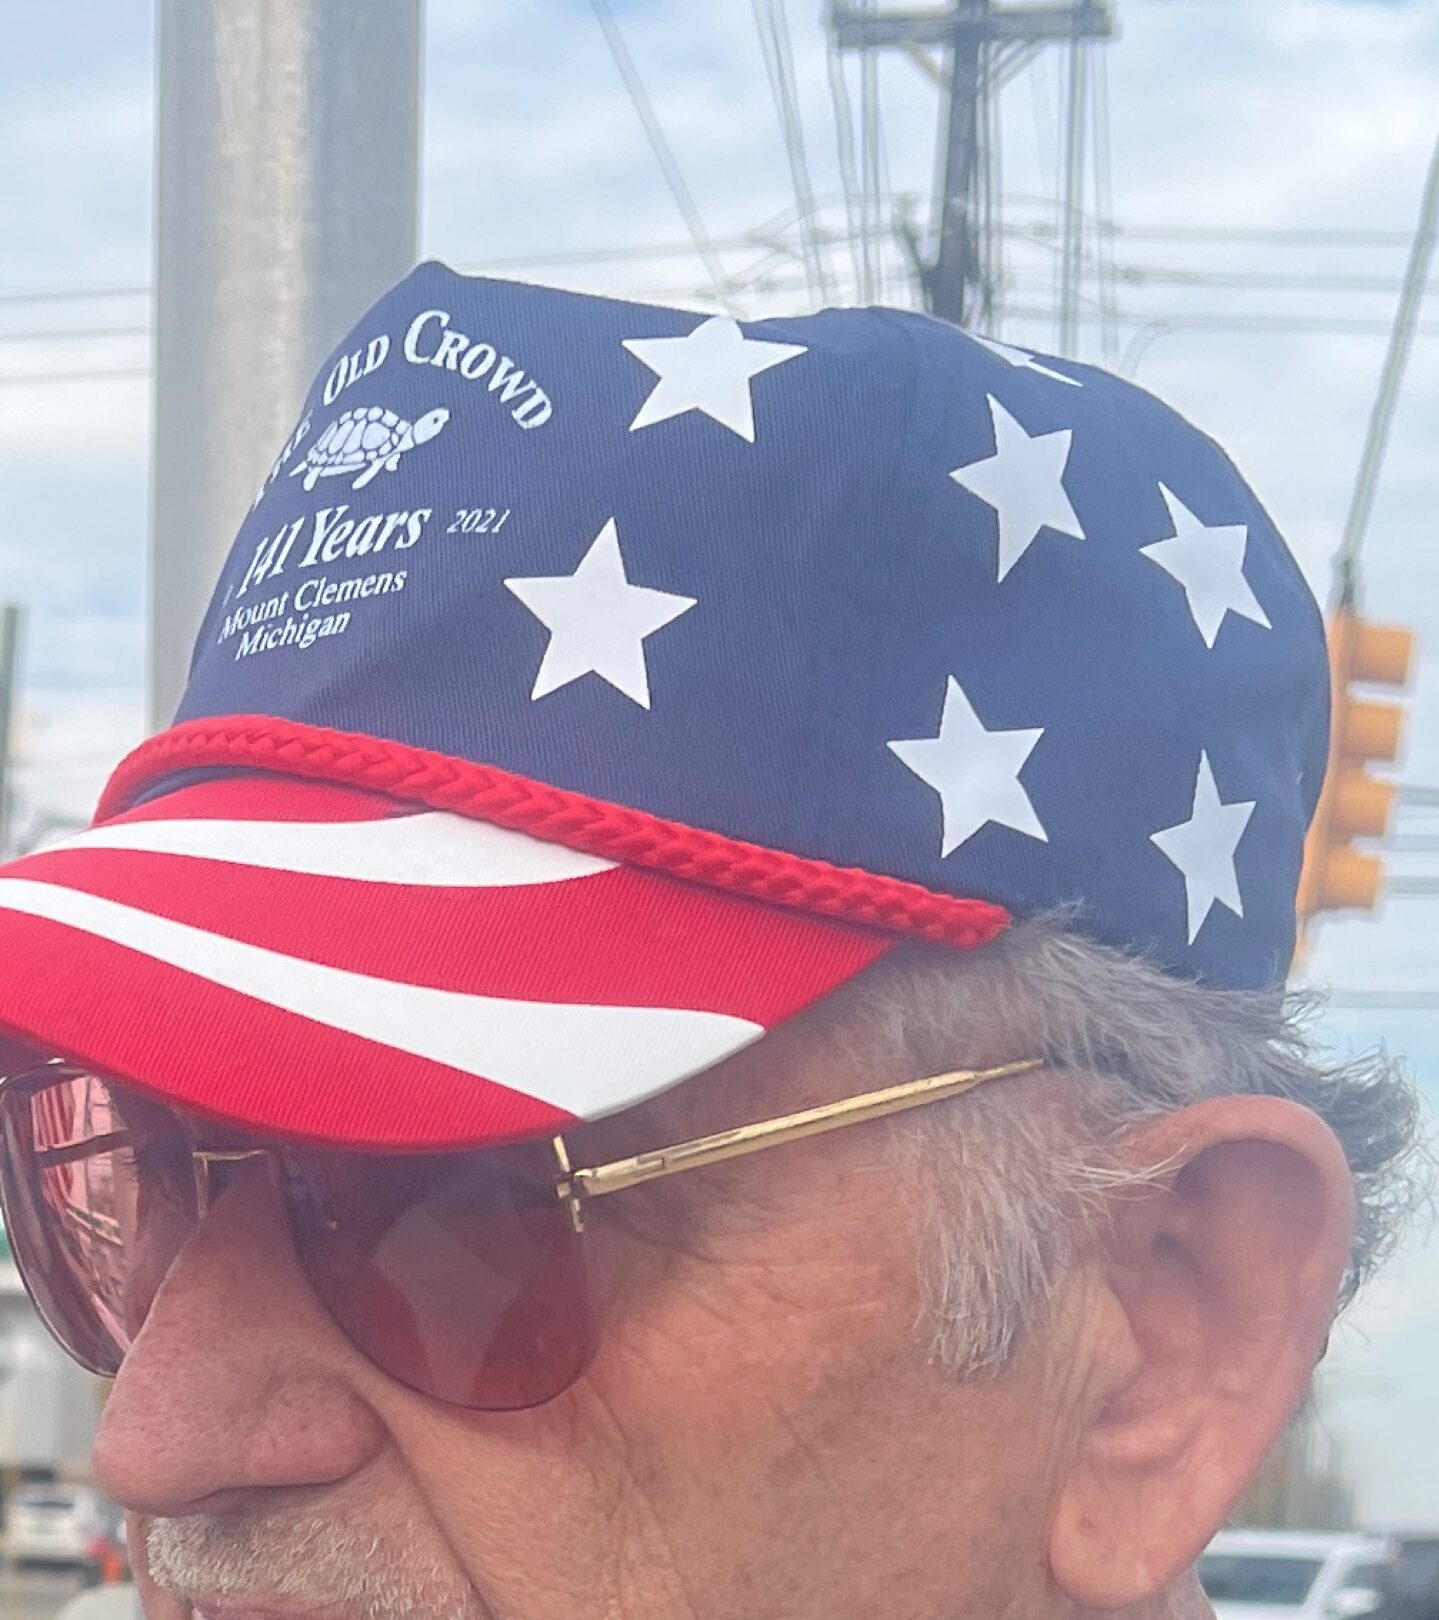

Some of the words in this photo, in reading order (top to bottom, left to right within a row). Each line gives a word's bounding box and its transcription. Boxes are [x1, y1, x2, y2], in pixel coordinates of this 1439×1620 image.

[323, 334, 390, 406] OLD
[404, 309, 553, 430] CROWD
[298, 504, 432, 568] Years
[446, 507, 511, 534] 2021
[217, 592, 289, 644] Mount
[293, 570, 407, 612] Clemens
[234, 611, 351, 661] Michigan
